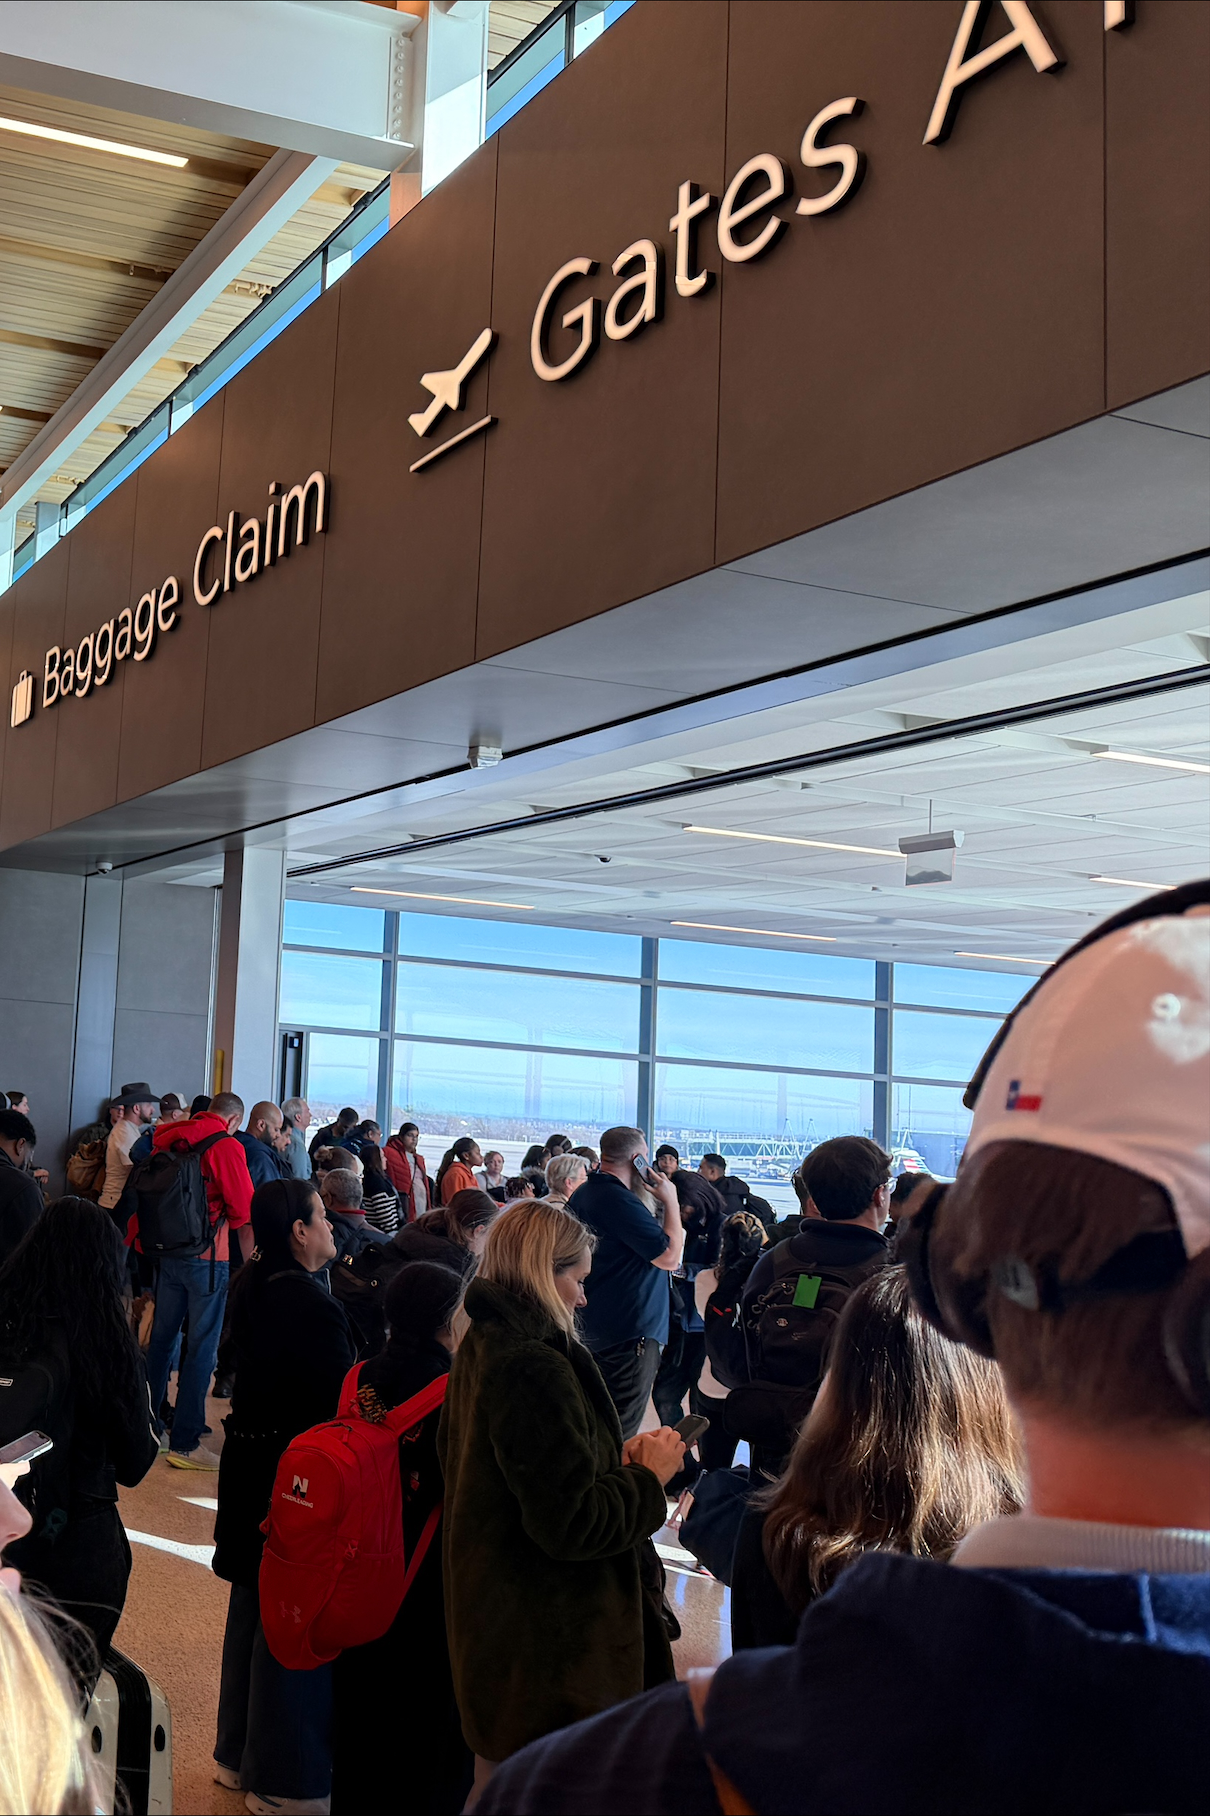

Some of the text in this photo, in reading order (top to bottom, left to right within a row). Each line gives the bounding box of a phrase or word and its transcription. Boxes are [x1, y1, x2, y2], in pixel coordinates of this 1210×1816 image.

[531, 96, 858, 382] Gates
[43, 470, 327, 708] Baggage Claim
[292, 1474, 309, 1499] N
